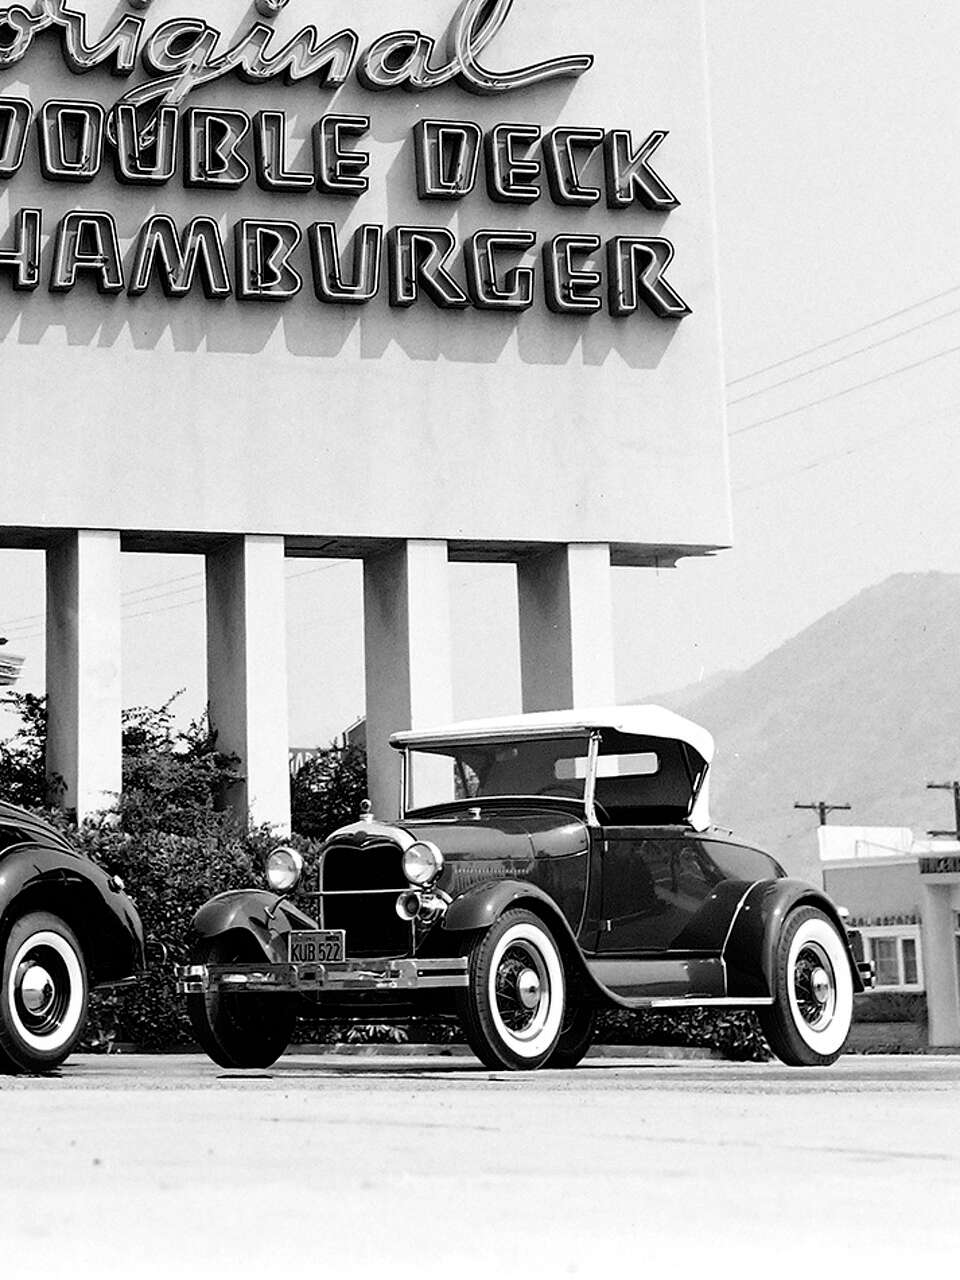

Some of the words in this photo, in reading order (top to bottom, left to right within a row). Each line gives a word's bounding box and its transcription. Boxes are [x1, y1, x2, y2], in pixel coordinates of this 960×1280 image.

[413, 117, 681, 210] DECK
[291, 943, 316, 961] KUB
[318, 943, 341, 961] 522
